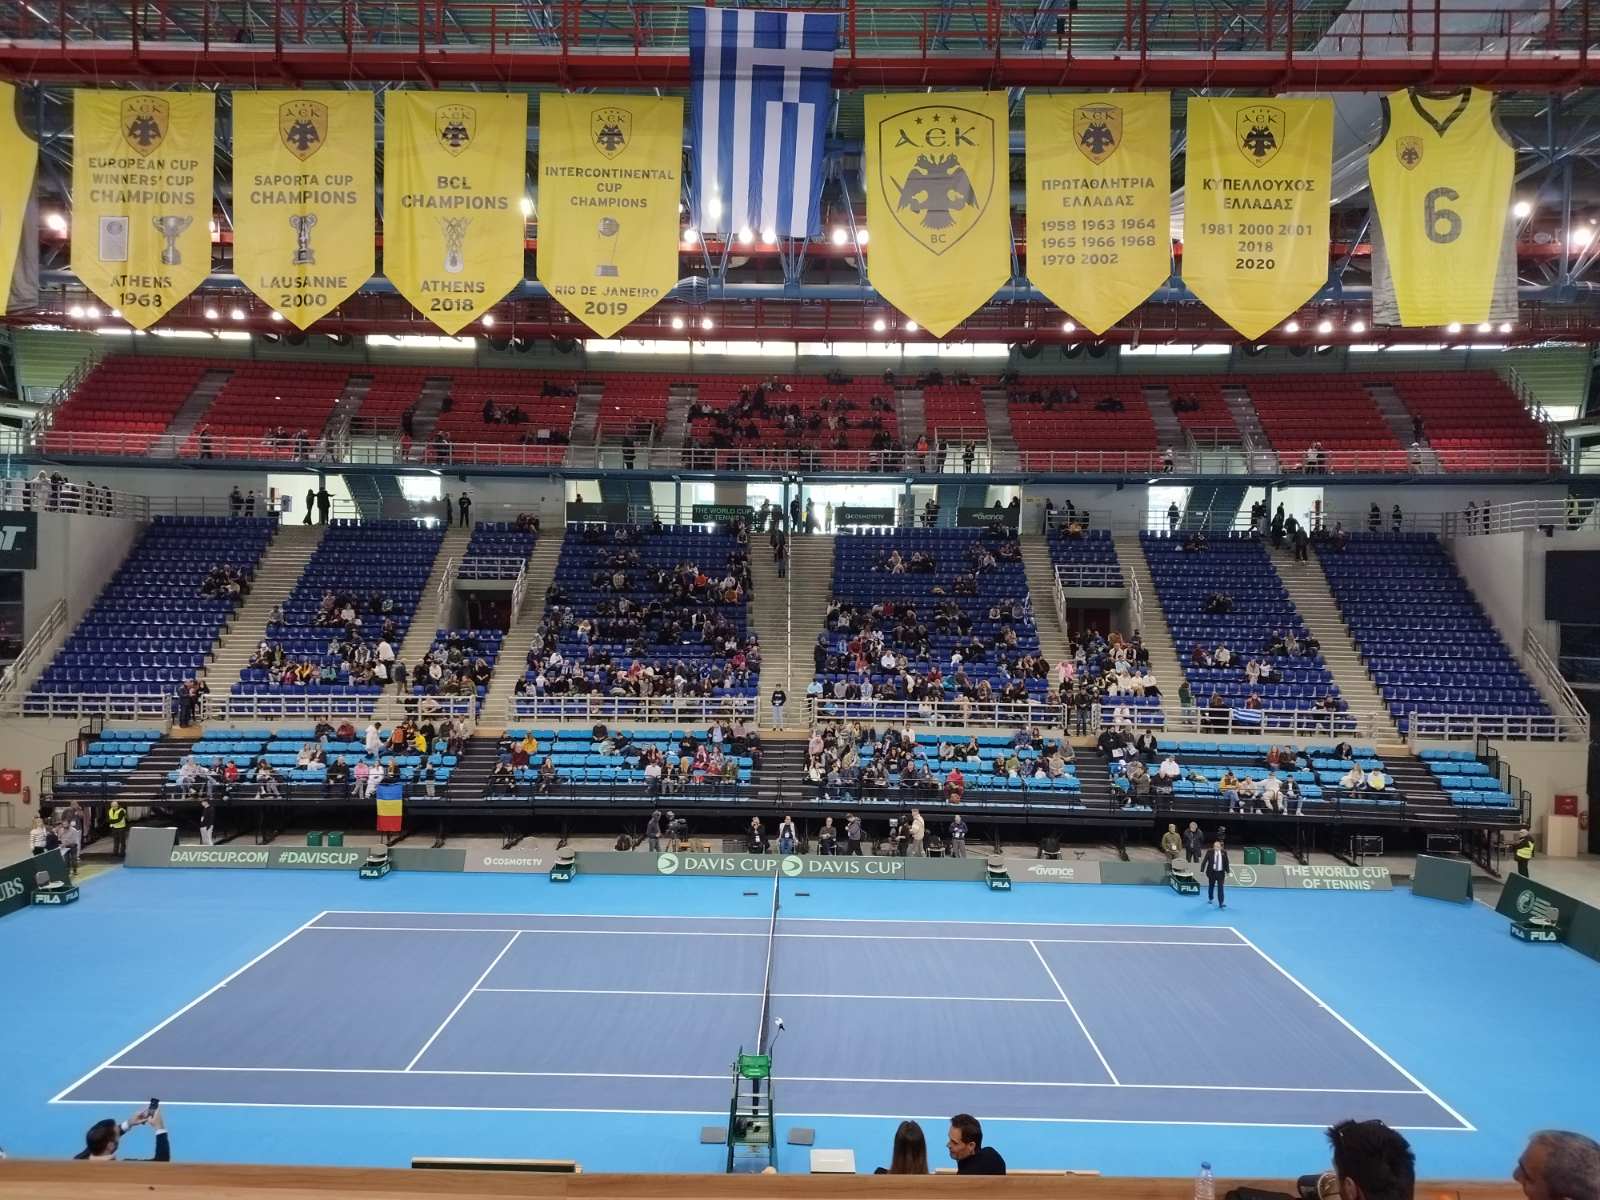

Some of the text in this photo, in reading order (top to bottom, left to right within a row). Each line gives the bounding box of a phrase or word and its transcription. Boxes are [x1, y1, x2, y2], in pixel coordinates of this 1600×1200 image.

[88, 158, 199, 171] EUROPEAN CUP
[545, 166, 675, 180] INTERCONTINENTAL
[92, 174, 194, 186] WINNERS' CUP
[254, 175, 354, 187] SAPORTA CUP
[436, 176, 472, 190] BCL
[1041, 177, 1156, 191] ΠΡΩΤΑΘΛΗΤΡΙΑ
[1202, 178, 1316, 192] ΚΥΠΕΛΛΟΥΧΟΣ
[596, 182, 623, 193] CUP
[90, 190, 195, 205] CHAMPIONS
[250, 190, 357, 205] CHAMPIONS
[401, 195, 509, 210] CHAMPIONS
[570, 196, 648, 208] CHAMPIONS
[1062, 195, 1135, 208] ΕΛΛΑΔΑΣ
[1223, 198, 1293, 211] ΕΛΛΑΔΑΣ
[1423, 187, 1463, 244] 6
[1041, 218, 1156, 232] 1958 1963 1964
[1200, 223, 1312, 237] 1981 2000 2001
[930, 233, 948, 244] BC
[1041, 235, 1156, 248] 1965 1966 1968
[1237, 240, 1274, 253] 2018
[1042, 253, 1119, 266] 1970 2002
[1235, 257, 1276, 270] 2020
[110, 274, 172, 289] ATHENS
[260, 275, 348, 289] LAUSANNE
[420, 281, 485, 294] ATHENS
[555, 285, 659, 298] RIO DE JANEIRO
[120, 292, 162, 308] 1968
[280, 294, 328, 308] 2000
[430, 298, 474, 312] 2018
[584, 301, 628, 315] 2019
[710, 507, 735, 515] WORLD
[170, 851, 270, 863] DAVISCUP.COM
[278, 851, 359, 864] #DAVISCUP
[684, 857, 777, 872] DAVIS CUP
[808, 860, 903, 875] DAVIS CUP
[360, 869, 378, 877] FILA
[1283, 865, 1390, 879] THE WORLD CUP
[991, 881, 1010, 889] FILA
[1180, 885, 1199, 893] FILA
[1302, 878, 1372, 891] OF TENNIS
[35, 894, 62, 904] FILA
[1530, 931, 1557, 940] FILA
